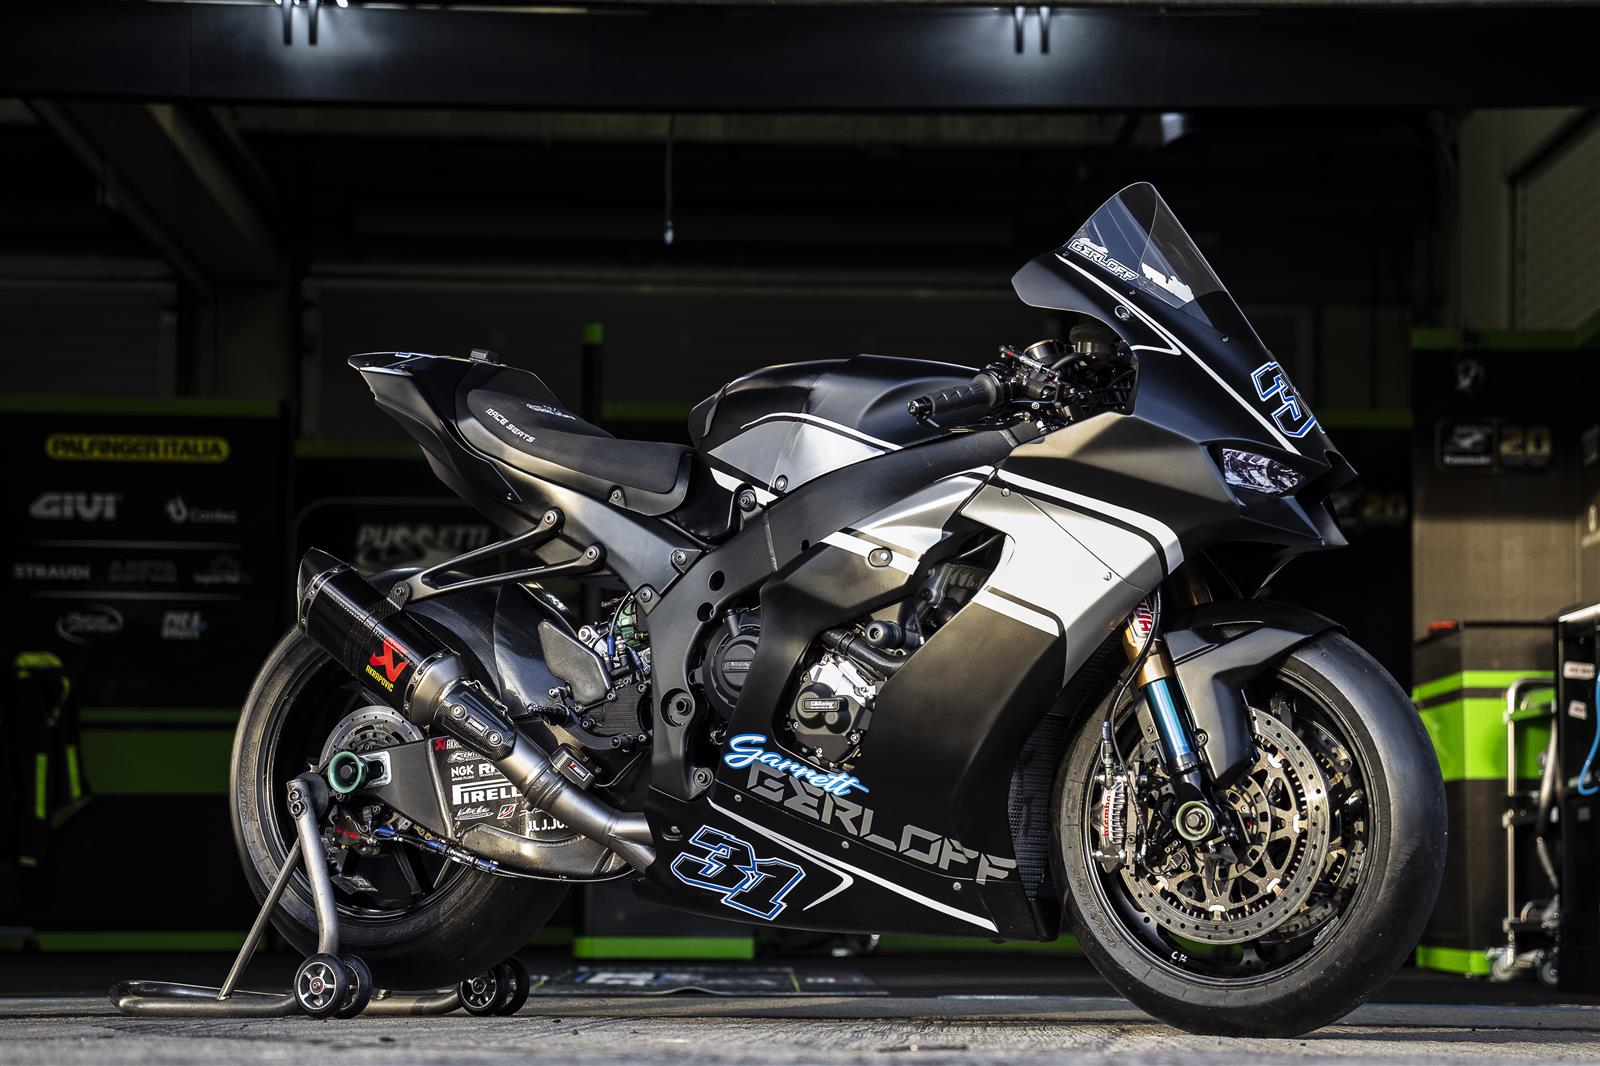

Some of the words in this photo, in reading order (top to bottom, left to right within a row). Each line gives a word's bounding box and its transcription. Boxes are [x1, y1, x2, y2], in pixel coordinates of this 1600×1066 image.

[1069, 239, 1138, 281] GERLOFF
[1251, 361, 1317, 438] 3
[485, 408, 509, 426] RACE
[505, 423, 536, 443] SEATS
[29, 490, 119, 520] GIVI
[451, 764, 474, 777] NGK
[724, 733, 870, 797] Garrett
[452, 779, 522, 805] PIRELL
[746, 760, 1018, 886] GERLOFF
[1103, 795, 1111, 836] brembo
[670, 824, 807, 921] 31
